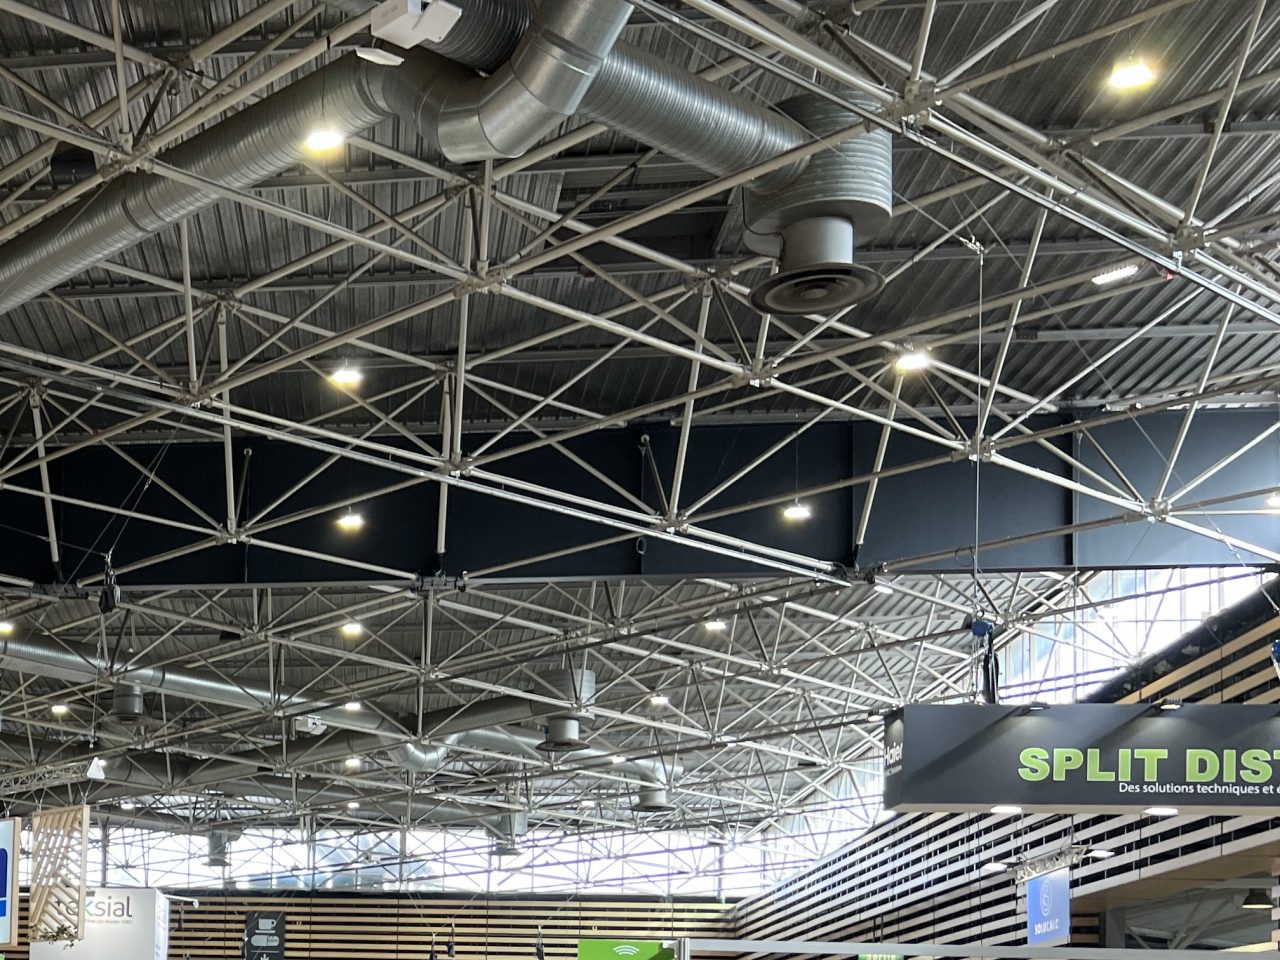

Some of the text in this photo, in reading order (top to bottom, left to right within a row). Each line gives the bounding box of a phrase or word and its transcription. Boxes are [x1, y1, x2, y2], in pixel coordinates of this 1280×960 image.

[1017, 747, 1169, 782] SPLIT
[1119, 782, 1141, 794] Des
[1142, 782, 1195, 794] solutions
[1196, 783, 1260, 796] techniques
[1262, 784, 1275, 795] et
